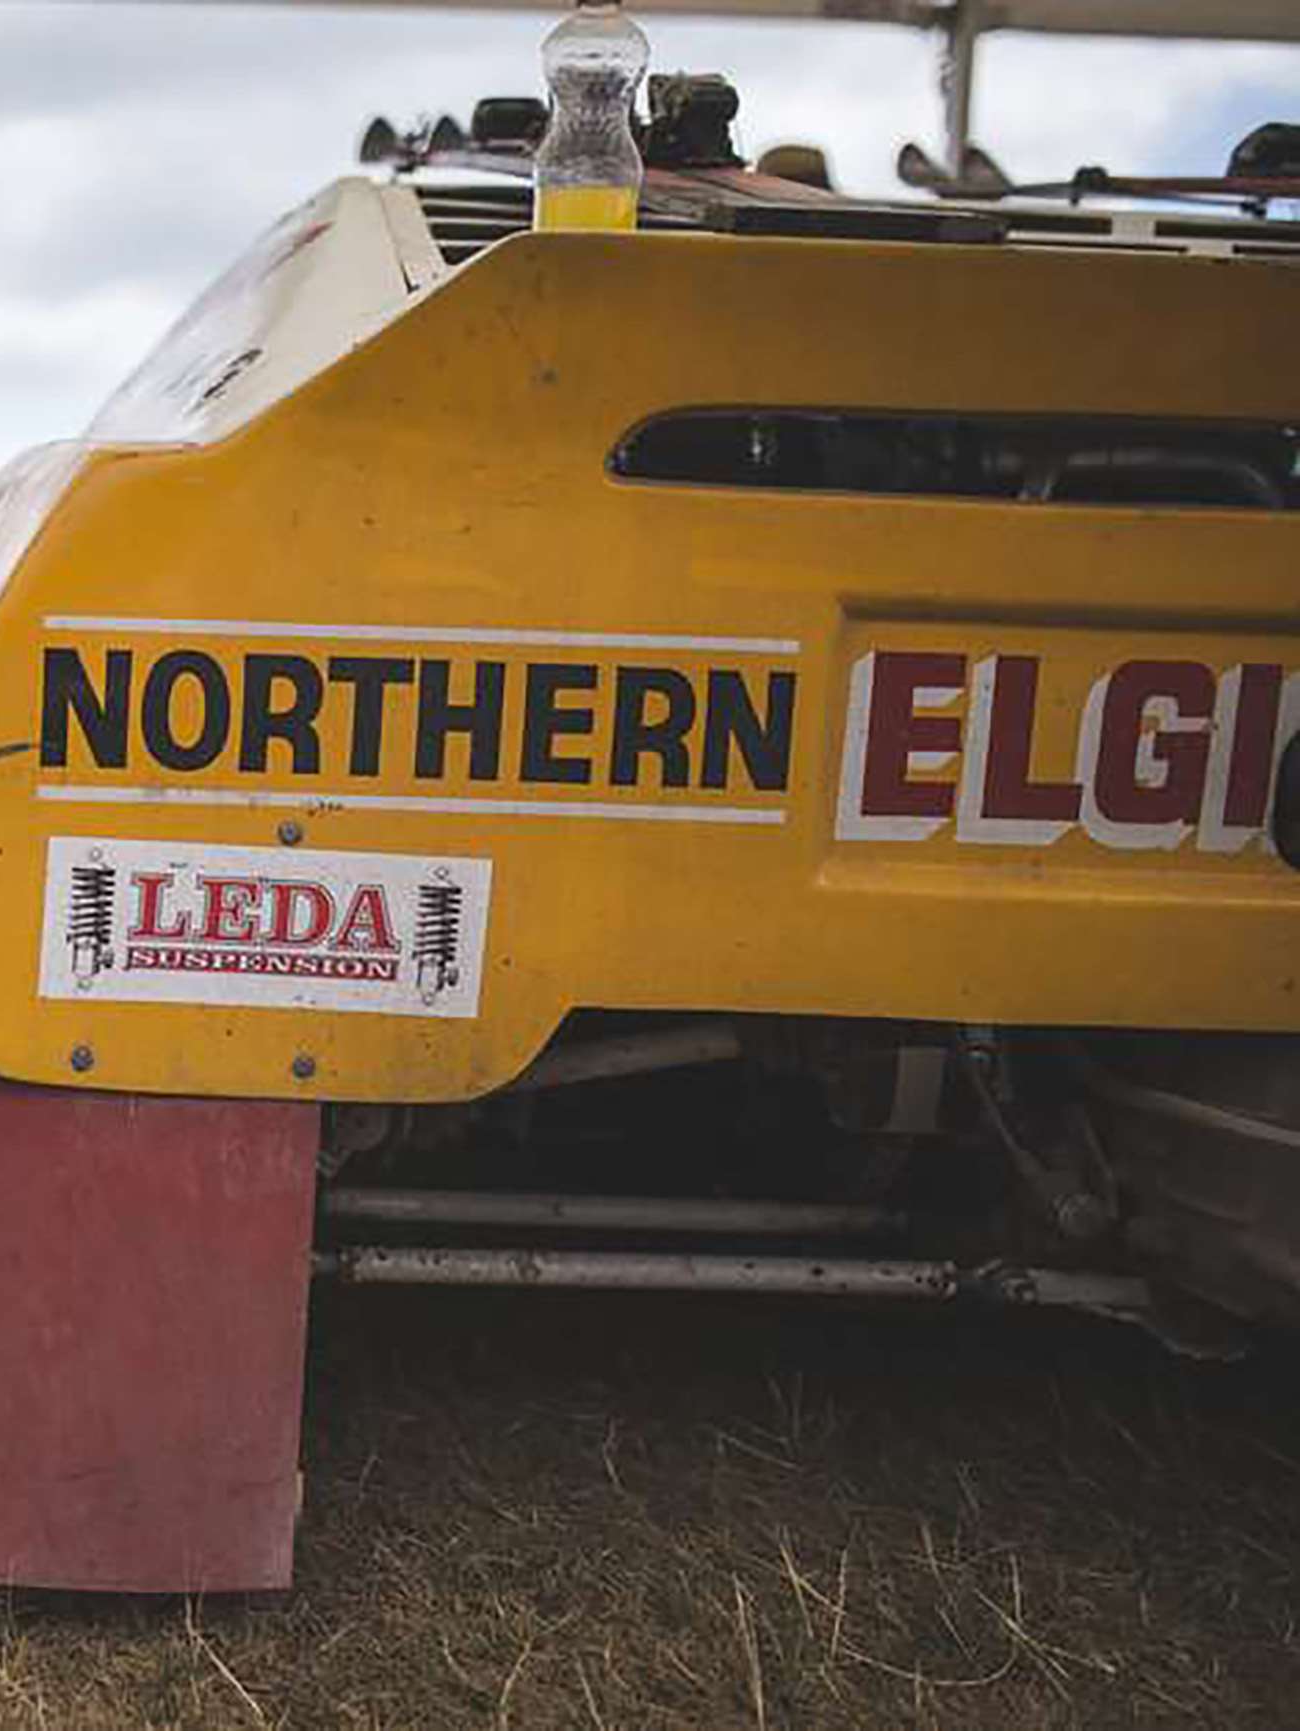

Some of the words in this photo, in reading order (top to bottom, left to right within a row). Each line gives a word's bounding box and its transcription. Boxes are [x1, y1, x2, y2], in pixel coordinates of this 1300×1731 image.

[39, 647, 797, 792] NORTHERN
[835, 650, 1300, 854] ELGI
[127, 871, 401, 953] LEDA
[128, 948, 399, 980] SUSPENSION
